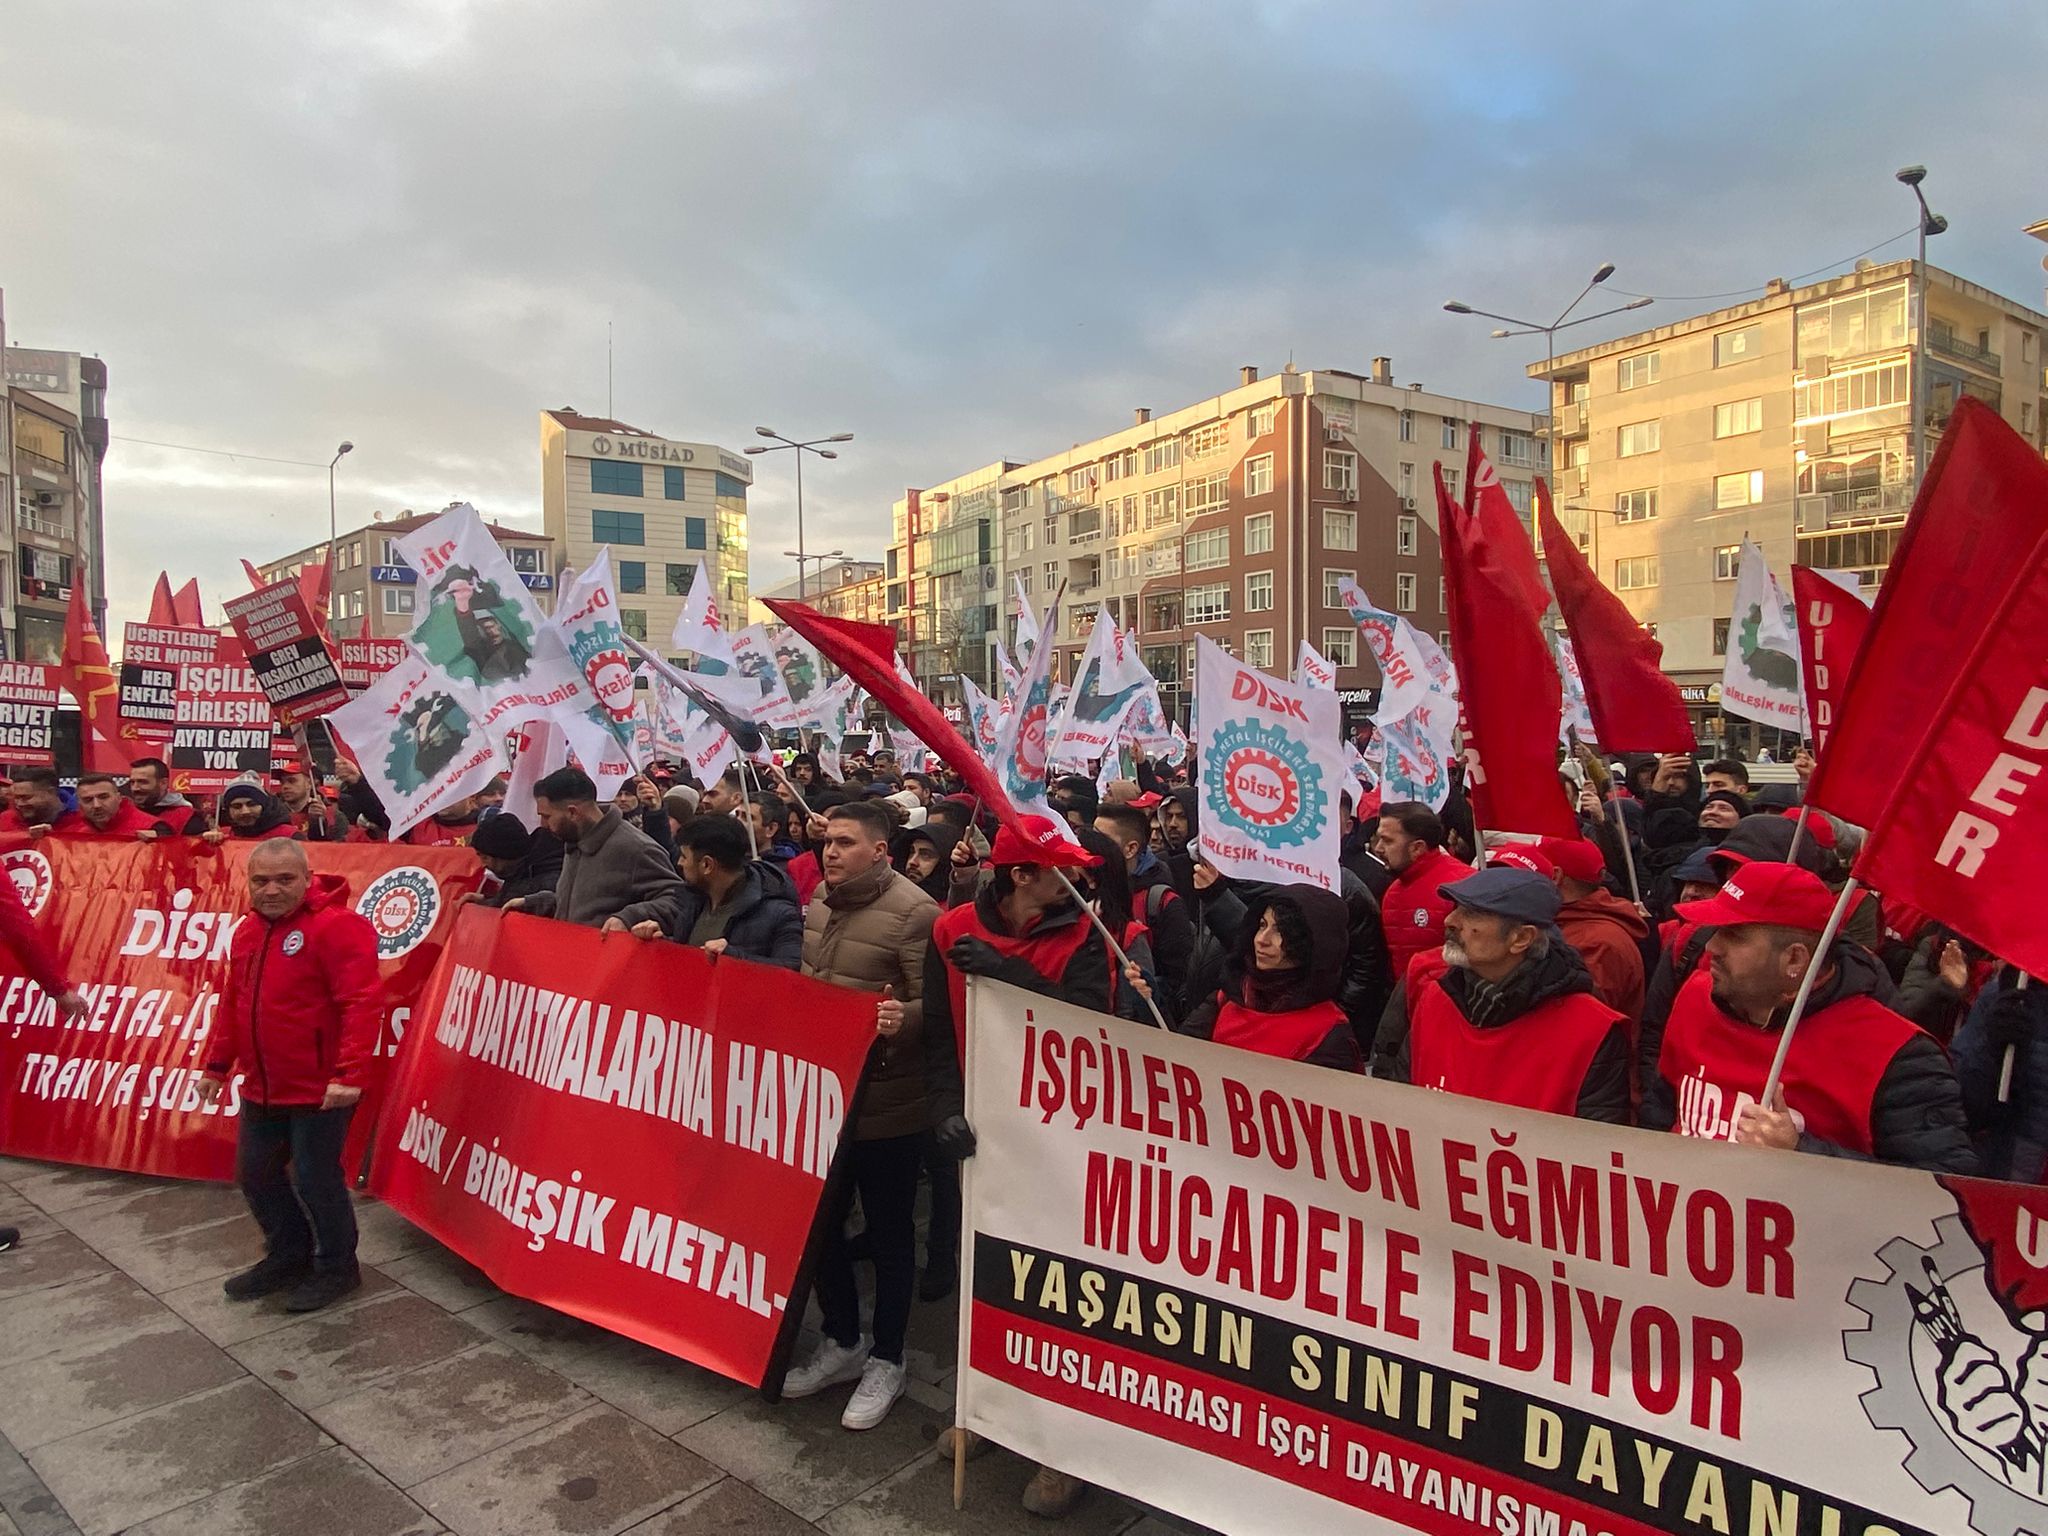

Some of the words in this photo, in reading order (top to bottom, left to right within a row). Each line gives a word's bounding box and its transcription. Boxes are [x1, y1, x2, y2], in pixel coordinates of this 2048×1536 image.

[618, 441, 695, 463] MÜSİAD
[127, 625, 218, 649] ÜCRETLERDE
[125, 644, 162, 663] EŞEL
[270, 644, 300, 666] GREV
[141, 670, 173, 687] HER
[258, 651, 329, 688] YASAKLAMAK
[264, 666, 338, 703] YASAKLANSIN
[1725, 687, 1774, 709] BİRLEŞİK
[177, 698, 270, 727] BİRLEŞİN
[174, 729, 213, 748] AYRI
[217, 731, 268, 749] GAYRI
[1220, 731, 1251, 756] METAL
[203, 751, 238, 769] YOK
[1237, 774, 1283, 801] DİSK
[1201, 833, 1258, 863] BİRLEŞİK
[1263, 854, 1331, 889] METAL-İŞ
[120, 887, 247, 962] DİSK
[384, 903, 409, 917] DİSK
[20, 1053, 141, 1107] TRAKYA
[471, 974, 714, 1138] DAYATMALARINA
[724, 1040, 844, 1181] HAYIR
[1019, 1009, 1209, 1147] İŞÇİLER
[1222, 1076, 1420, 1211] BOYUN
[1442, 1128, 1795, 1299] EĞMİYOR
[399, 1100, 448, 1174] DİSK
[464, 1135, 616, 1253] BİRLEŞİK
[1084, 1143, 1420, 1341] MÜCADELE
[1452, 1249, 1743, 1441] EDİYOR
[1009, 1249, 1253, 1371] YAŞASIN
[1290, 1334, 1480, 1440] SINIF
[1006, 1330, 1241, 1438] ULUSLARARASI
[1258, 1403, 1329, 1470] İŞÇİ
